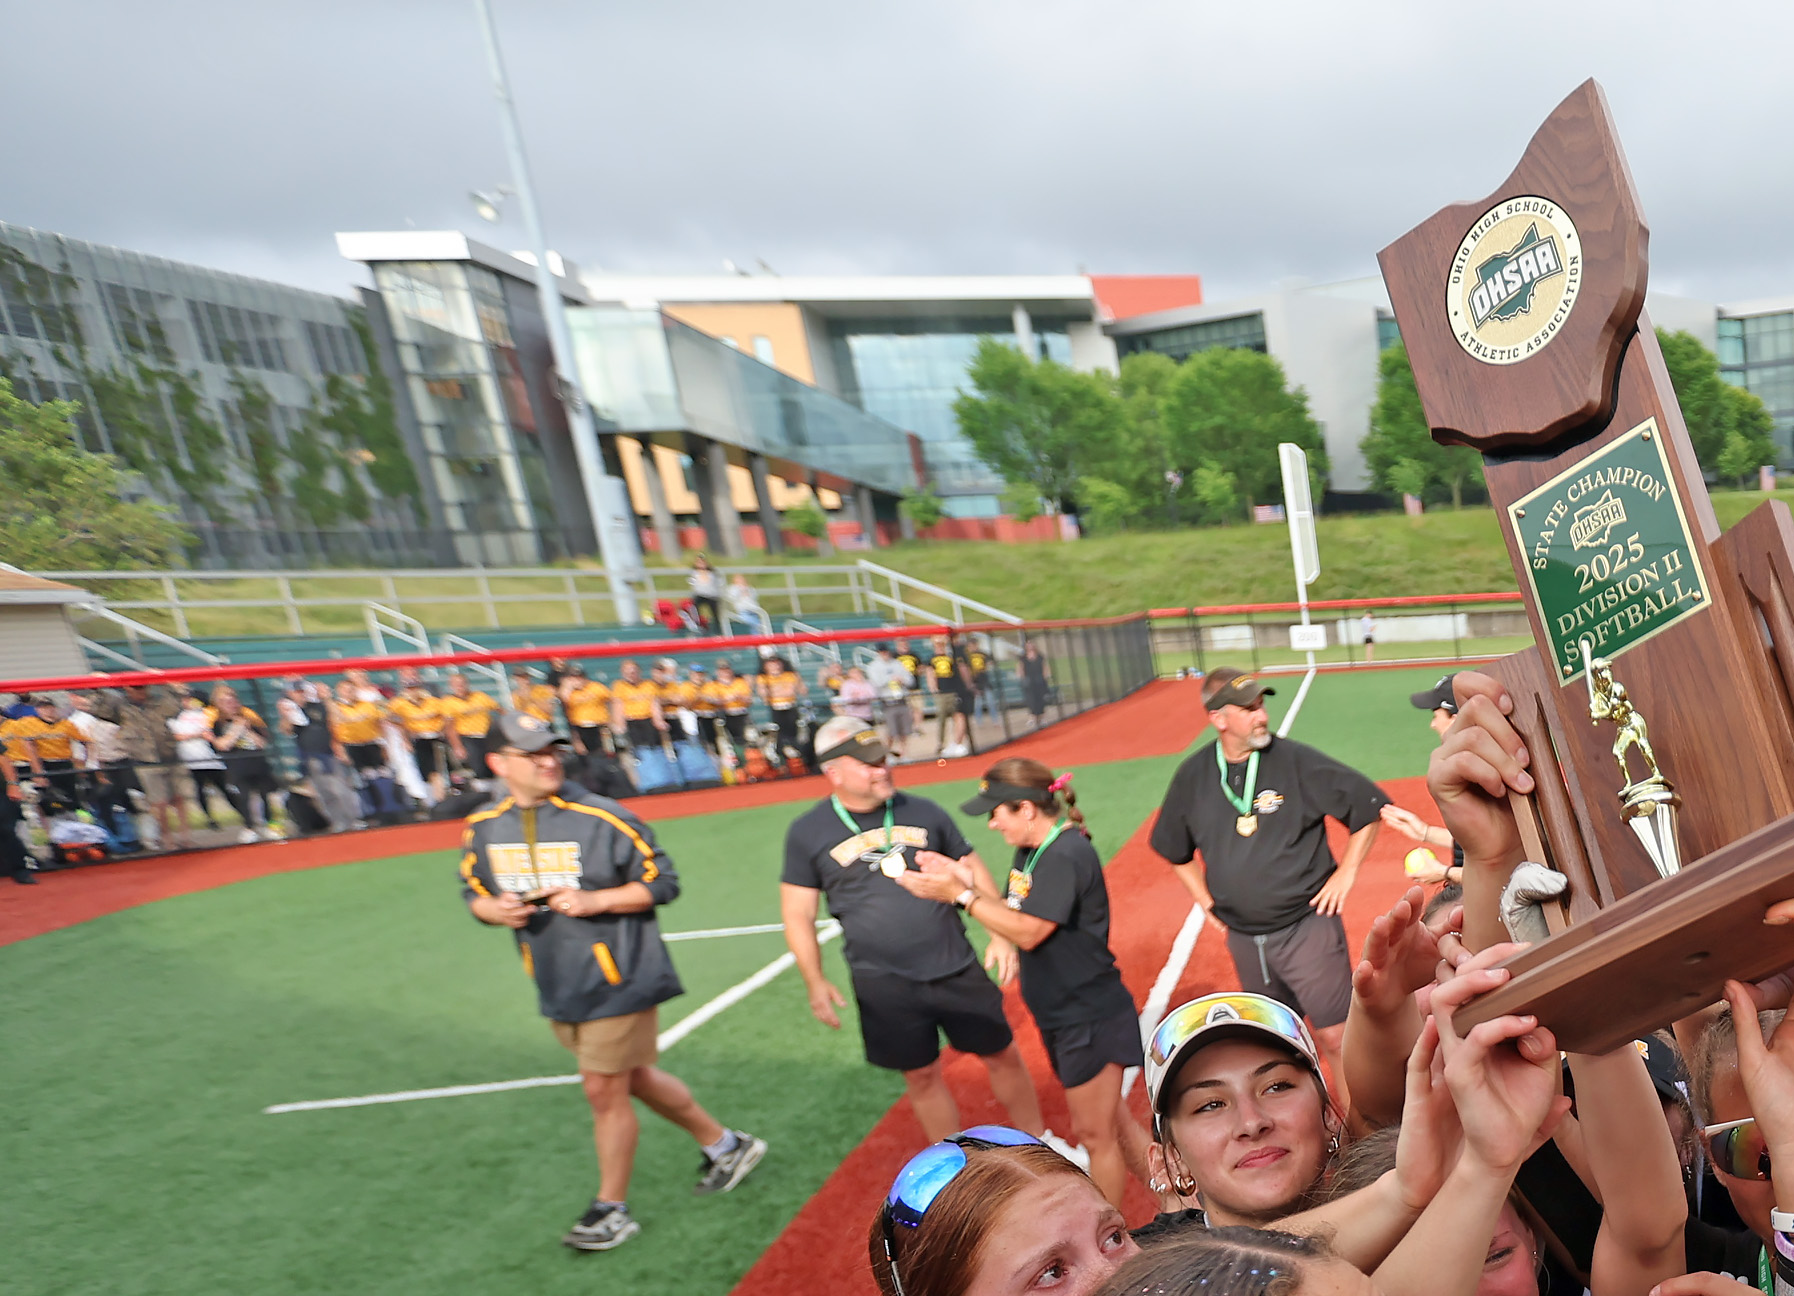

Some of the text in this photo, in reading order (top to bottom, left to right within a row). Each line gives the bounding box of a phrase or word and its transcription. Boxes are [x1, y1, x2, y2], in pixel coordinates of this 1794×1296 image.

[1453, 201, 1553, 284] OHIO HIGH SCHOOL
[1472, 242, 1558, 320] OHSAA
[1461, 255, 1579, 360] ATHLETIC ASSOCIATION
[1533, 466, 1666, 570] STATE CHAMPION
[1574, 503, 1622, 542] OHSAA
[1557, 549, 1684, 636] DIVISION II
[1574, 532, 1645, 594] 2025
[1563, 578, 1694, 663] SOFTBALL
